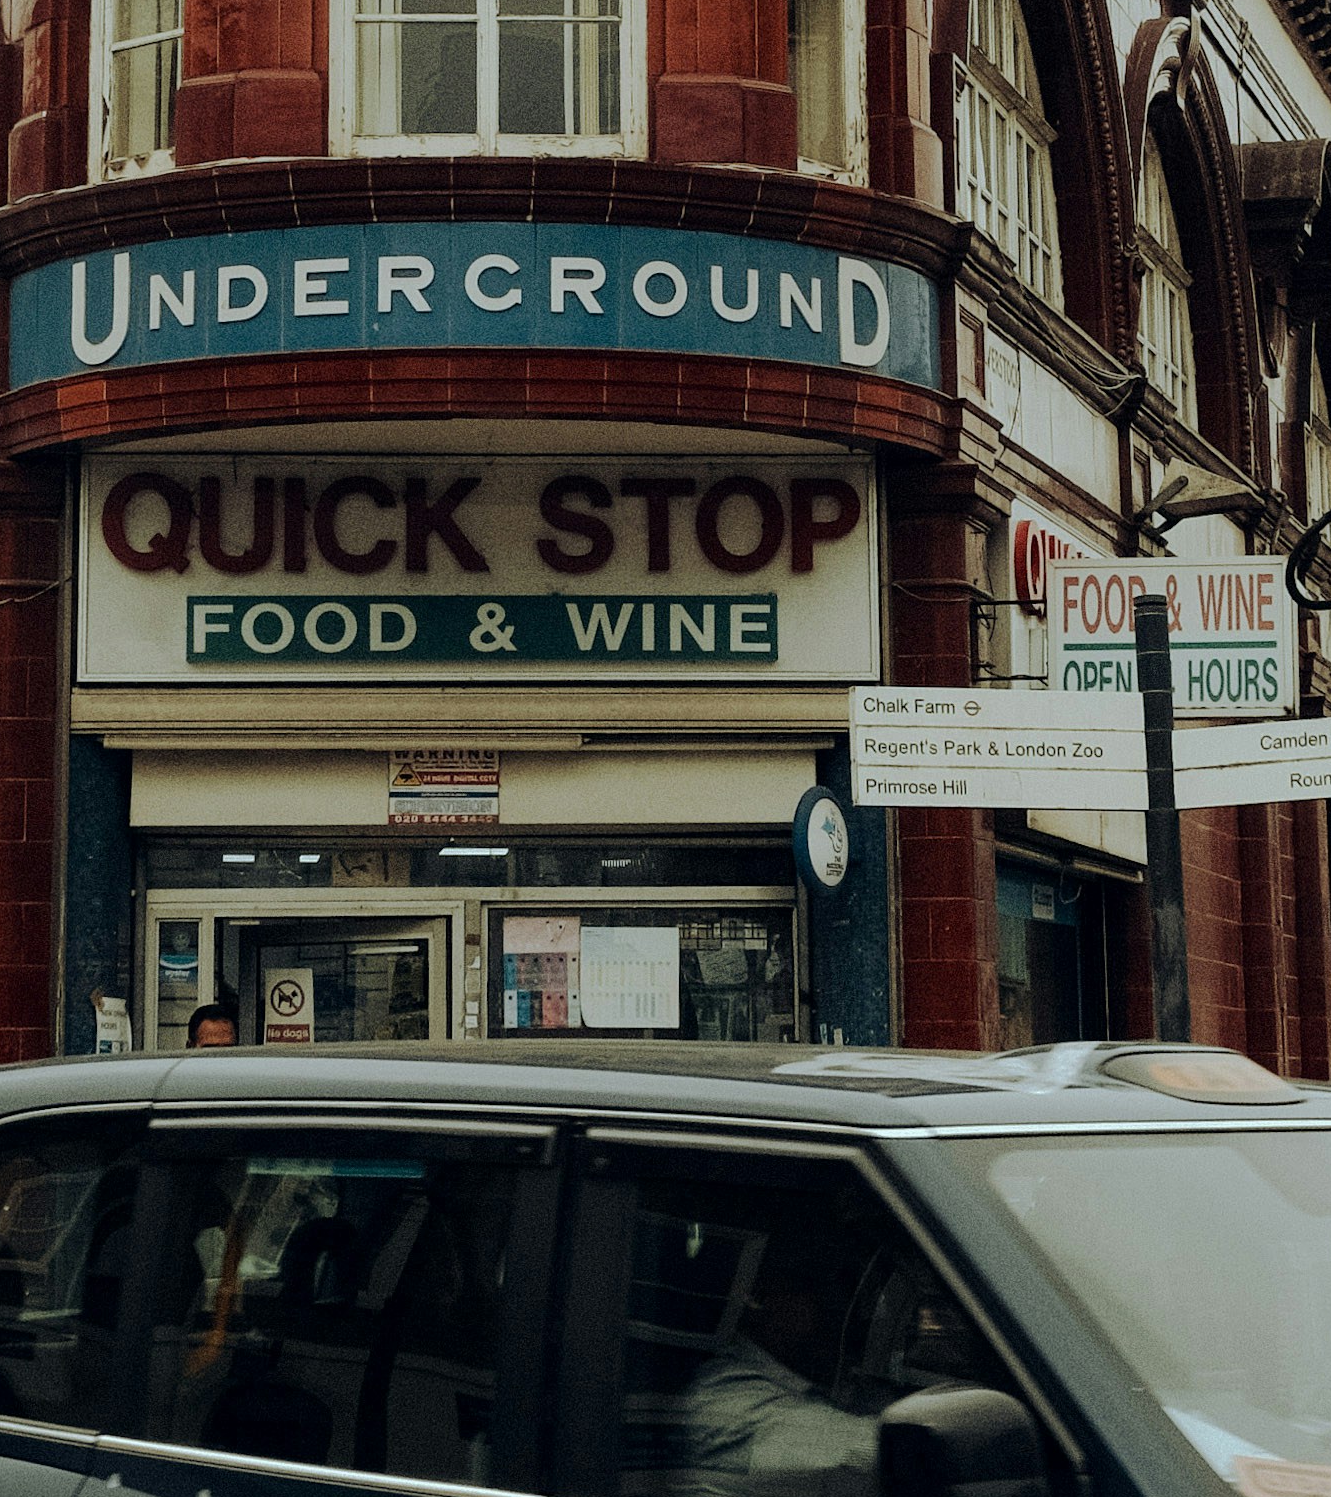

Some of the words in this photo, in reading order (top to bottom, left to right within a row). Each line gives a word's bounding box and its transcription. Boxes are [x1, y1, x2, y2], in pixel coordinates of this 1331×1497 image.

[71, 252, 890, 367] UNDERGROUND
[101, 470, 491, 575] QUICK
[536, 474, 861, 575] STOP
[1166, 573, 1183, 633] &
[1197, 573, 1275, 631] WINE
[191, 601, 419, 654] FOOD
[469, 602, 517, 654] &
[569, 601, 773, 654] WINE
[1063, 659, 1132, 693] OPEN
[1187, 657, 1279, 703] HOURS
[863, 696, 909, 714] Chalk
[914, 698, 956, 715] Farm
[864, 738, 938, 758] Regent's
[944, 740, 982, 756] Park
[988, 742, 999, 756] &
[1005, 741, 1067, 757] London
[1072, 742, 1104, 758] Zoo
[1260, 731, 1329, 751] Camden
[865, 778, 937, 795] Primrose
[943, 779, 967, 796] Hill
[282, 1027, 309, 1041] dogs
